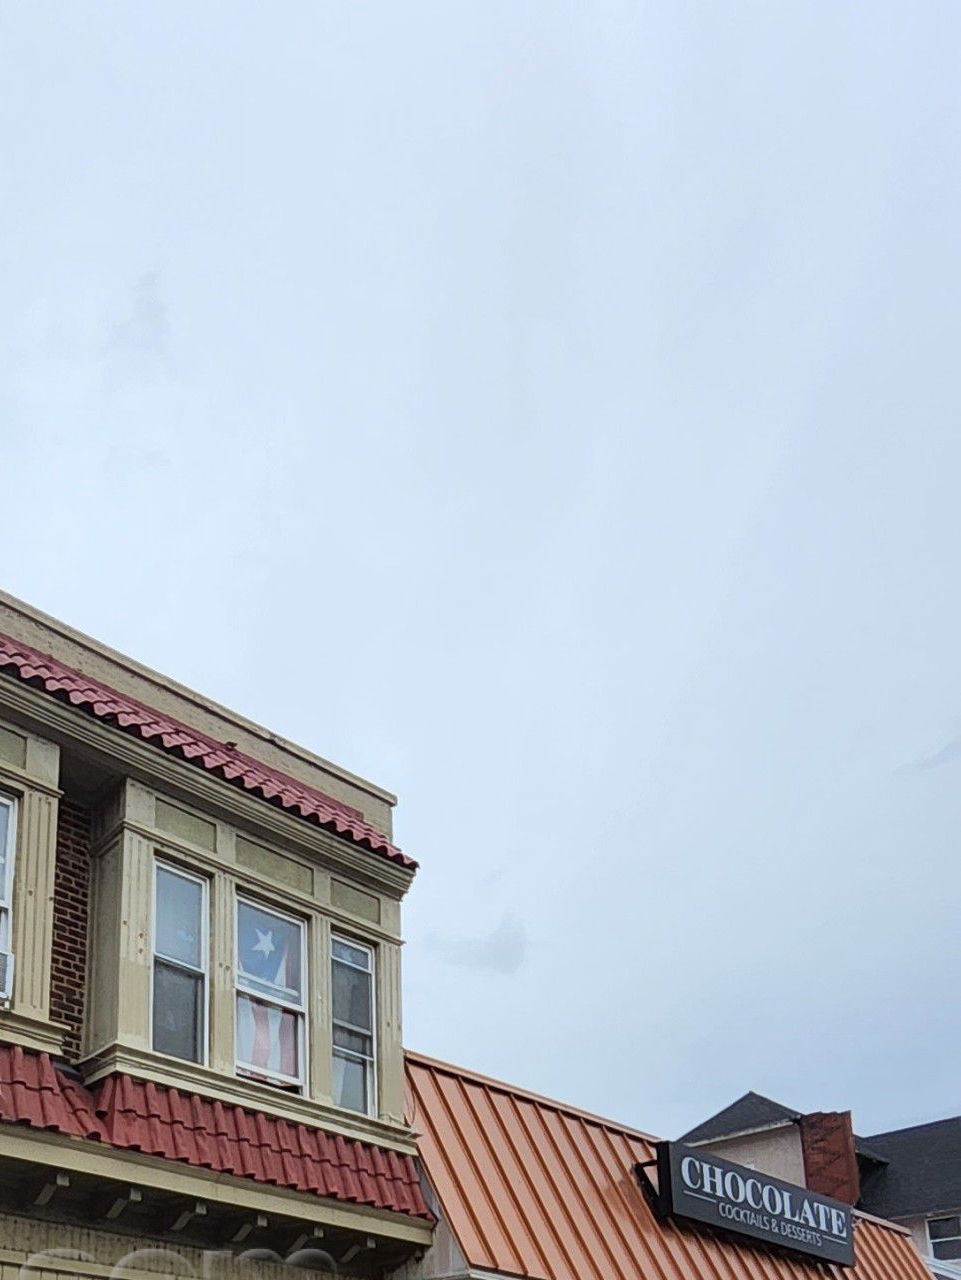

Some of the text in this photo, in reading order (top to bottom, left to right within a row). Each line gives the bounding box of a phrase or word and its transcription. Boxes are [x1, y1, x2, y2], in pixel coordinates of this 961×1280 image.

[681, 1156, 847, 1238] CHOCOLATE
[719, 1202, 822, 1246] COCKTAILS & DESSERTS
